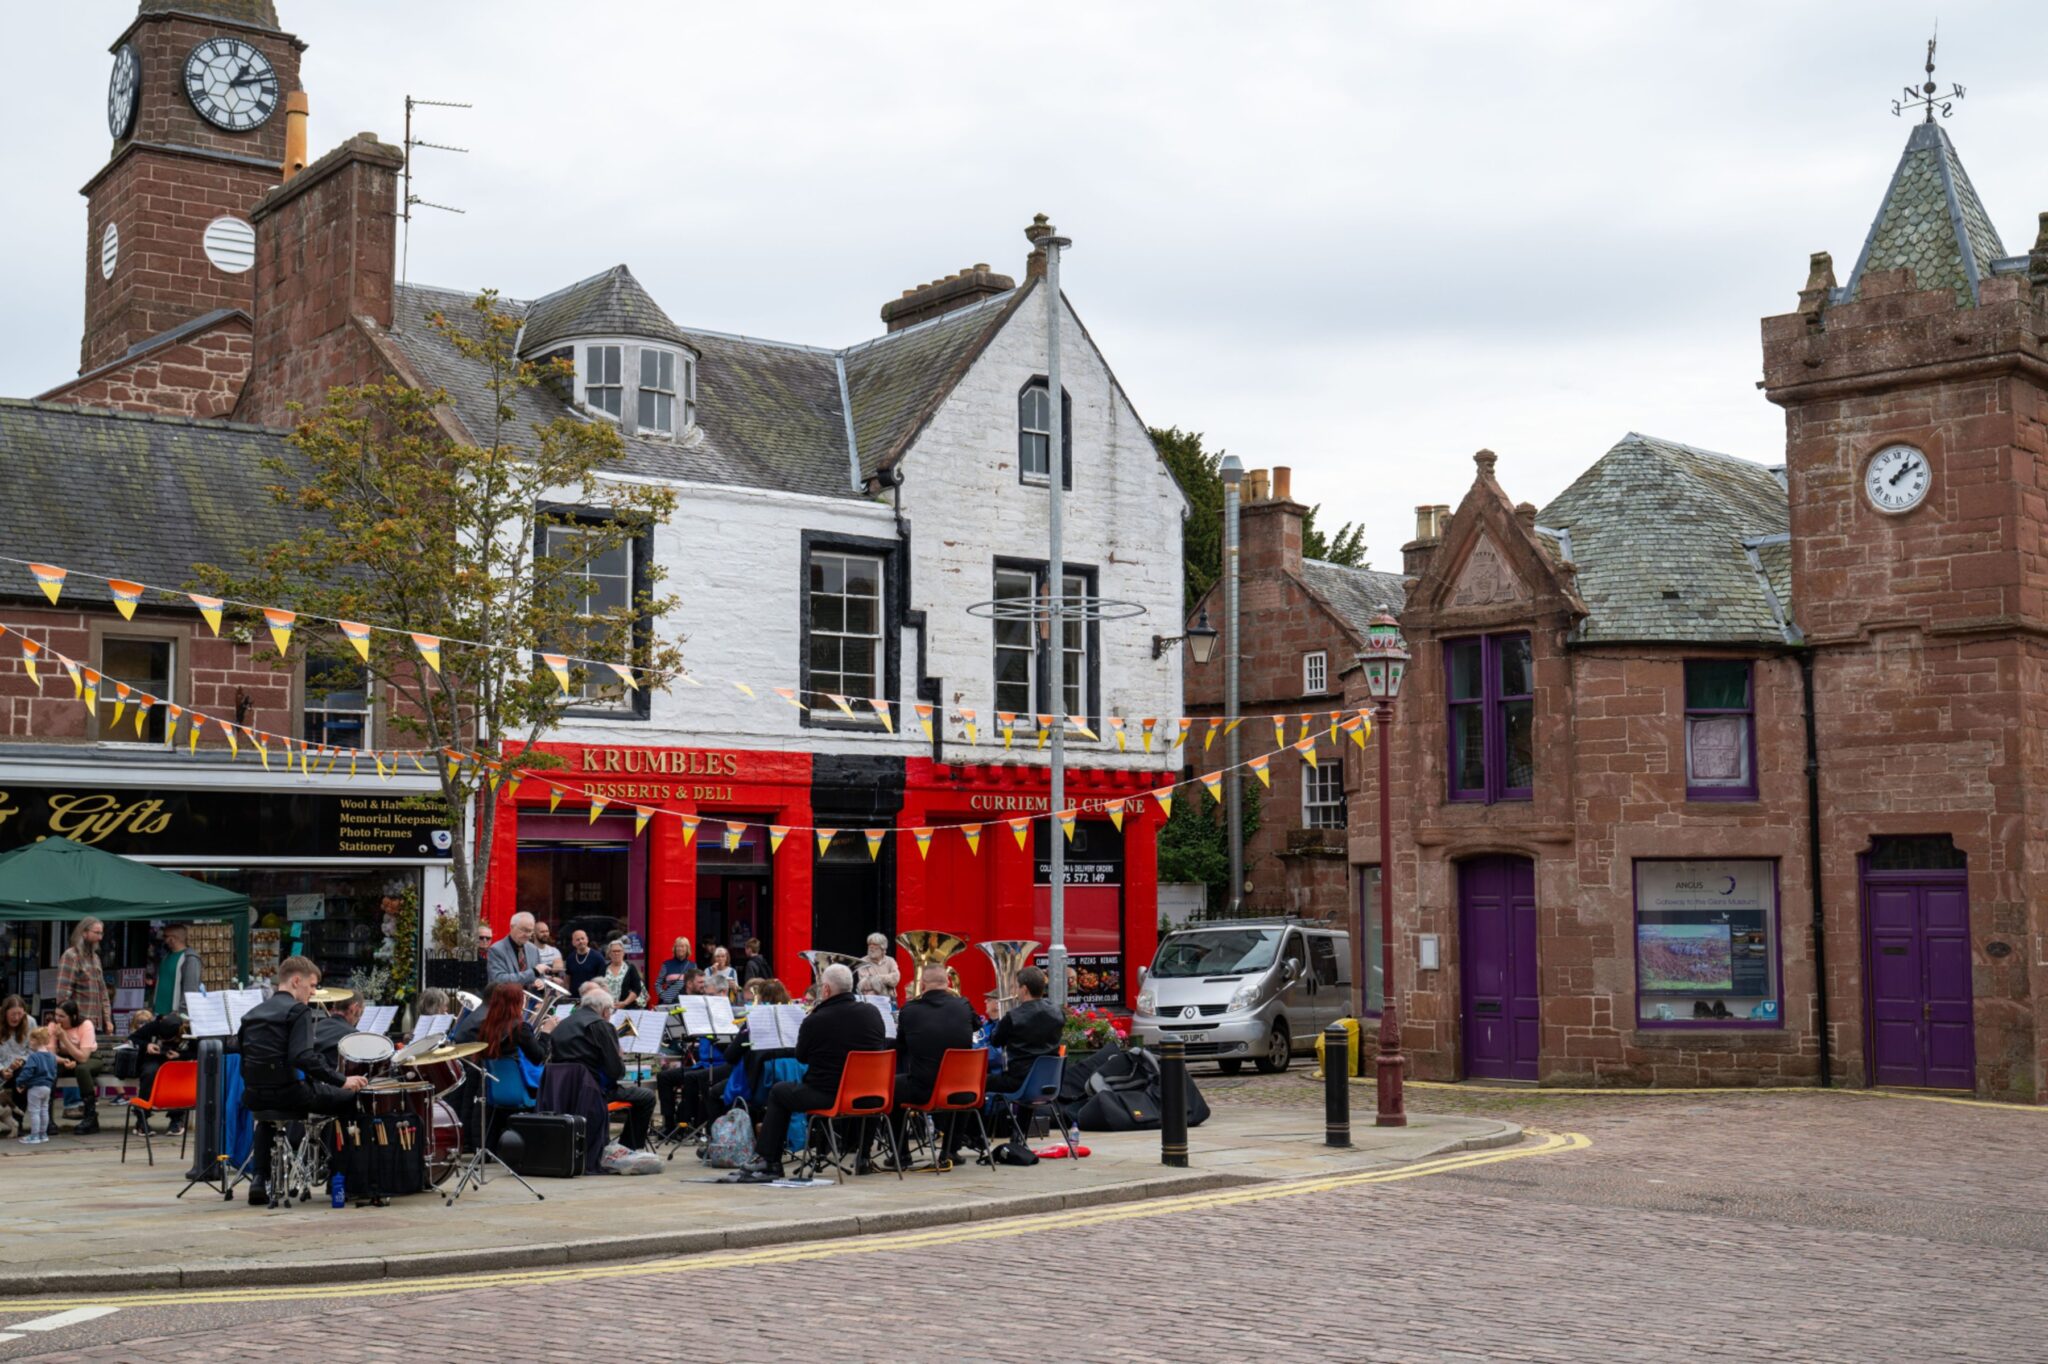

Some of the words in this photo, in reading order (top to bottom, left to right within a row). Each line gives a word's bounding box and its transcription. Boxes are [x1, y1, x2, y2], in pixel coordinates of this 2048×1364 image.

[582, 748, 738, 776] KRUMBLES
[584, 783, 671, 799] DESSERTS
[675, 786, 688, 800] &
[693, 786, 734, 801] DELI
[340, 800, 367, 809] Wool
[370, 800, 378, 809] &
[970, 794, 1077, 812] CURRIEMR
[1082, 798, 1145, 814] CUNE
[37, 794, 172, 845] Gifts
[340, 813, 392, 824] Memorial
[340, 827, 371, 838] Photo
[373, 828, 412, 839] Frames
[339, 841, 395, 854] Stationery
[1073, 873, 1089, 883] 572
[1092, 873, 1105, 883] 149
[1675, 881, 1704, 889] ANGUS
